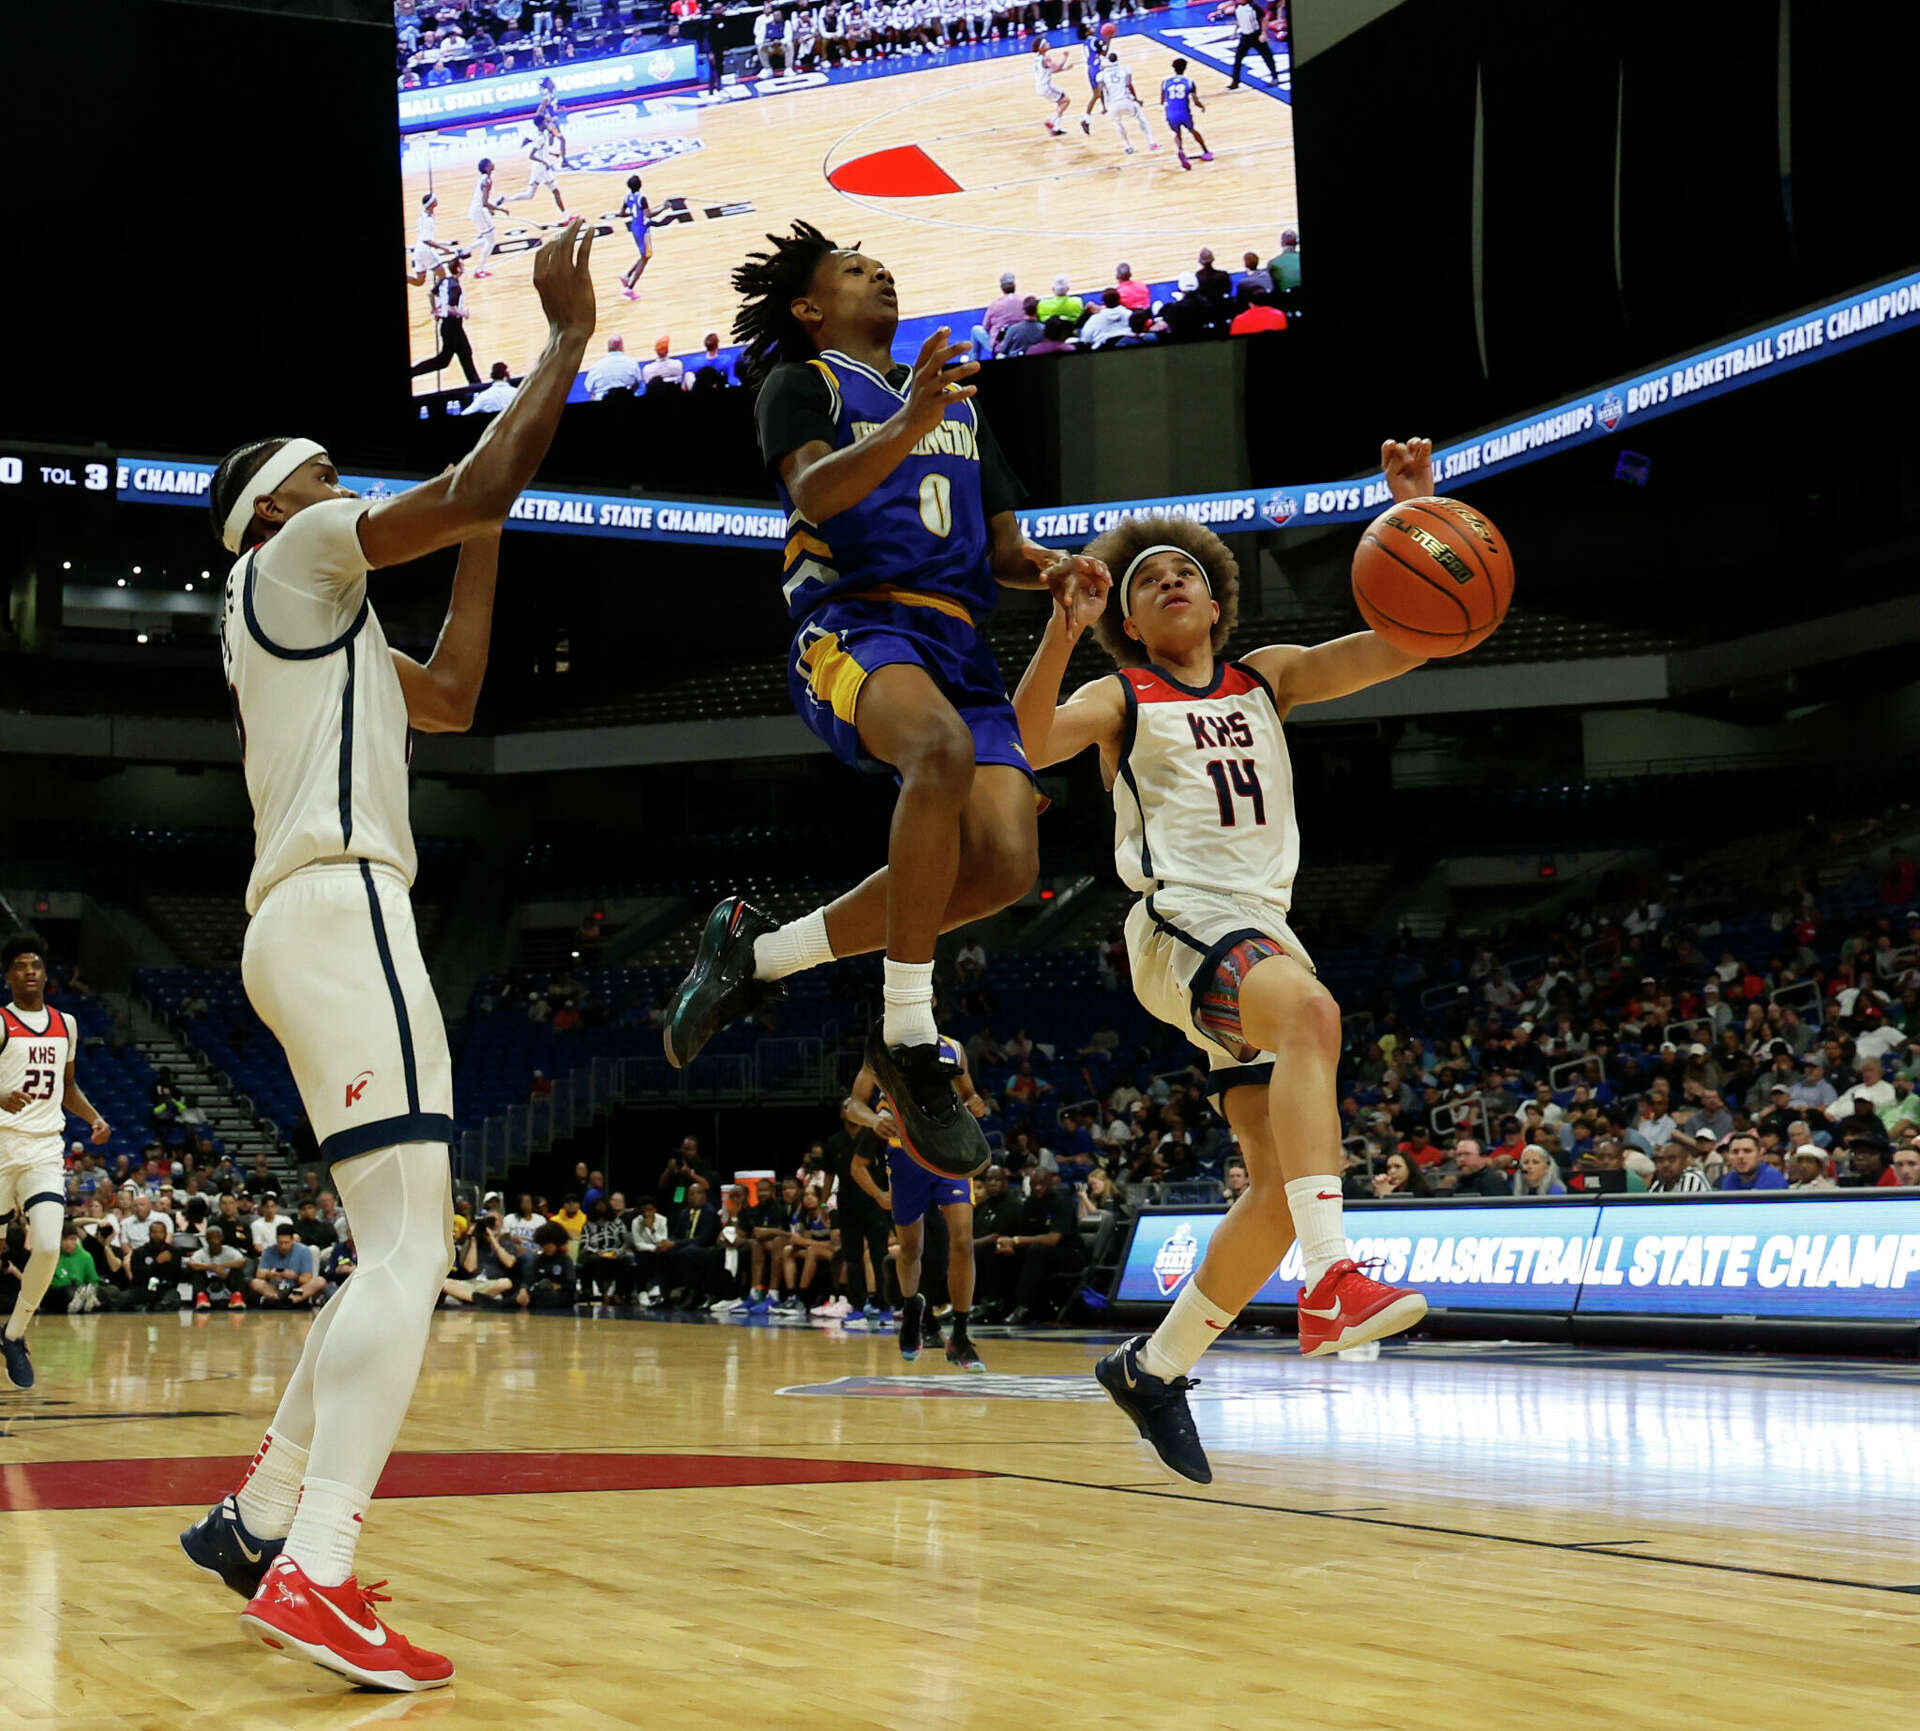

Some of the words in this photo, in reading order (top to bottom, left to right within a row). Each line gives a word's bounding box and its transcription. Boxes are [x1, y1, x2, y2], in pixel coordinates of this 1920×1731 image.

[444, 87, 495, 111] STATE
[1627, 376, 1669, 414] BOYS
[1671, 338, 1774, 398] BASKETBALL
[1776, 318, 1824, 360] STATE
[1444, 445, 1481, 479] STATE
[1482, 403, 1594, 465] CHAMPIONSHIPS
[40, 467, 77, 485] TOL
[84, 463, 109, 490] 3
[116, 466, 130, 489] E
[919, 473, 952, 539] 0
[1304, 488, 1361, 515] BOYS
[600, 504, 653, 529] STATE
[1035, 512, 1090, 539] STATE
[1186, 711, 1255, 750] KHS
[1206, 758, 1267, 827] 14
[28, 1046, 56, 1065] KHS
[22, 1069, 55, 1100] 23
[1407, 1236, 1624, 1286] BASKETBALL
[1628, 1235, 1758, 1288] STATE
[1757, 1234, 1920, 1289] CHAMP
